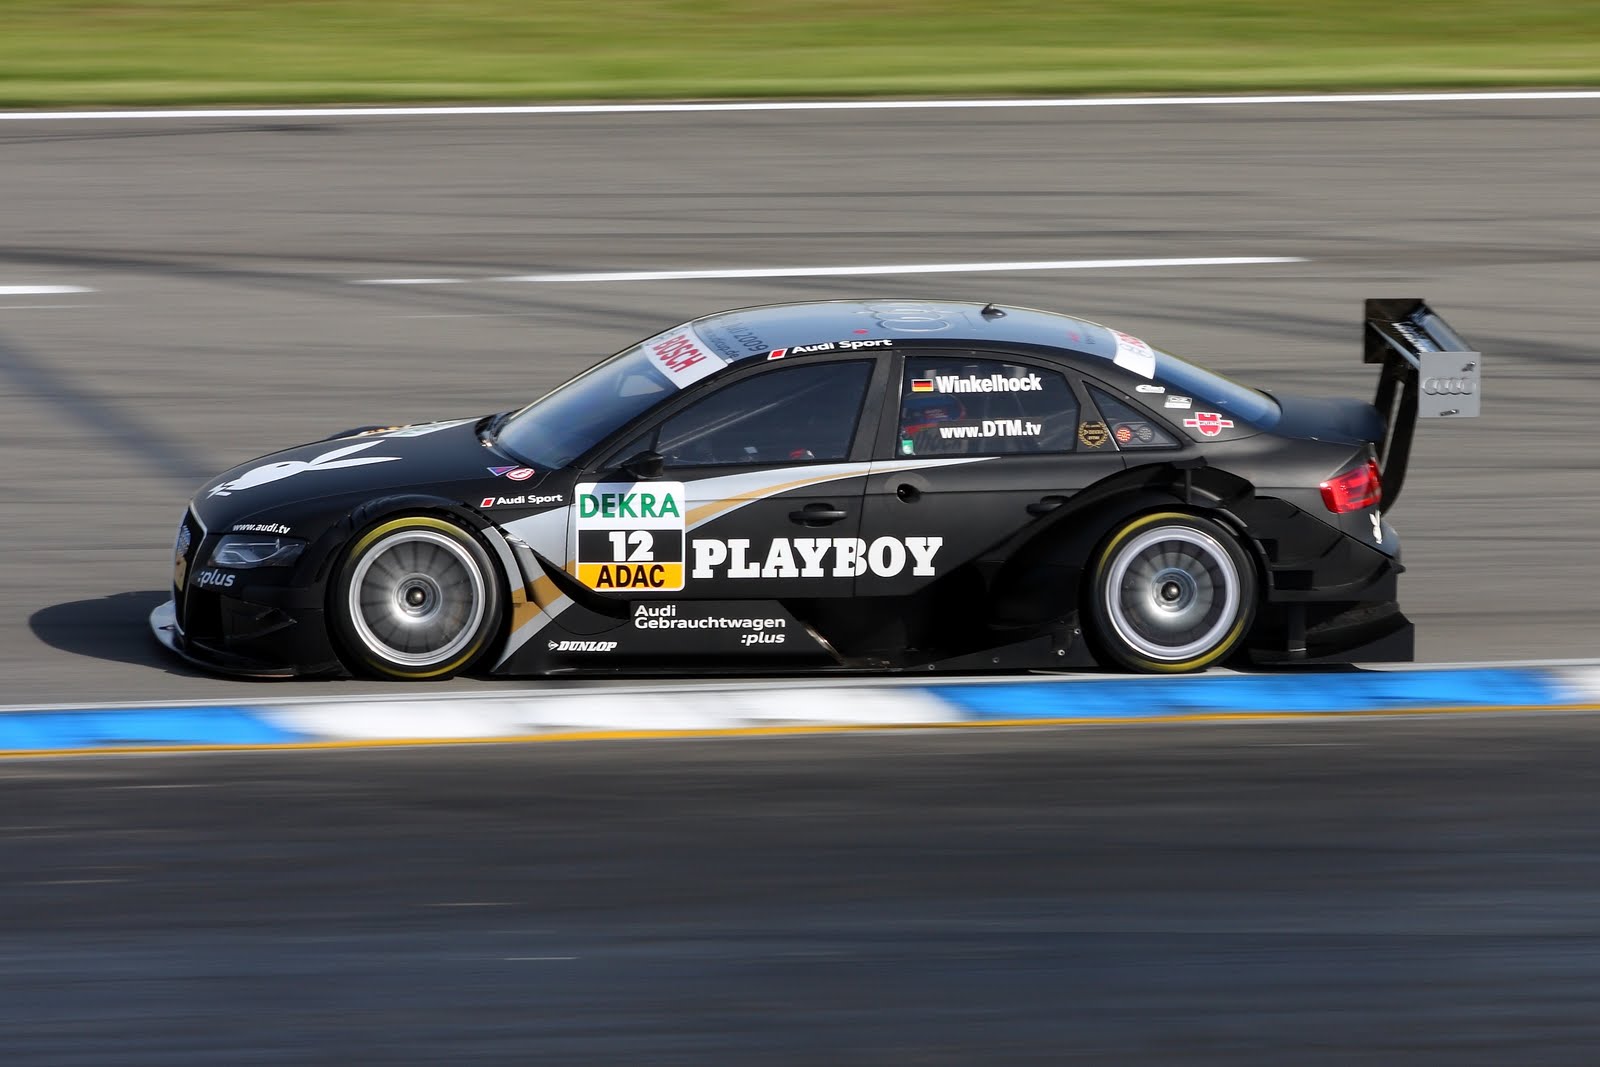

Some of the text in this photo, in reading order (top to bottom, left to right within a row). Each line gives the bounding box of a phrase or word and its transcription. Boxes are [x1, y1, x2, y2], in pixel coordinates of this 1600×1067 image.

[653, 334, 707, 373] BOSCH
[791, 338, 893, 355] Audi Sport
[935, 373, 1043, 393] Winkelhock
[939, 419, 1042, 439] www.DTM.tv
[496, 493, 563, 506] Audi Sport
[579, 492, 681, 518] DEKRA
[232, 523, 291, 534] www.audi.tv
[608, 530, 654, 562] 12
[692, 536, 943, 579] PLAYBOY
[595, 564, 665, 588] ADAC
[634, 604, 676, 617] Audi
[634, 616, 786, 631] Gebrauchtwagen
[557, 640, 618, 652] DUNLOP
